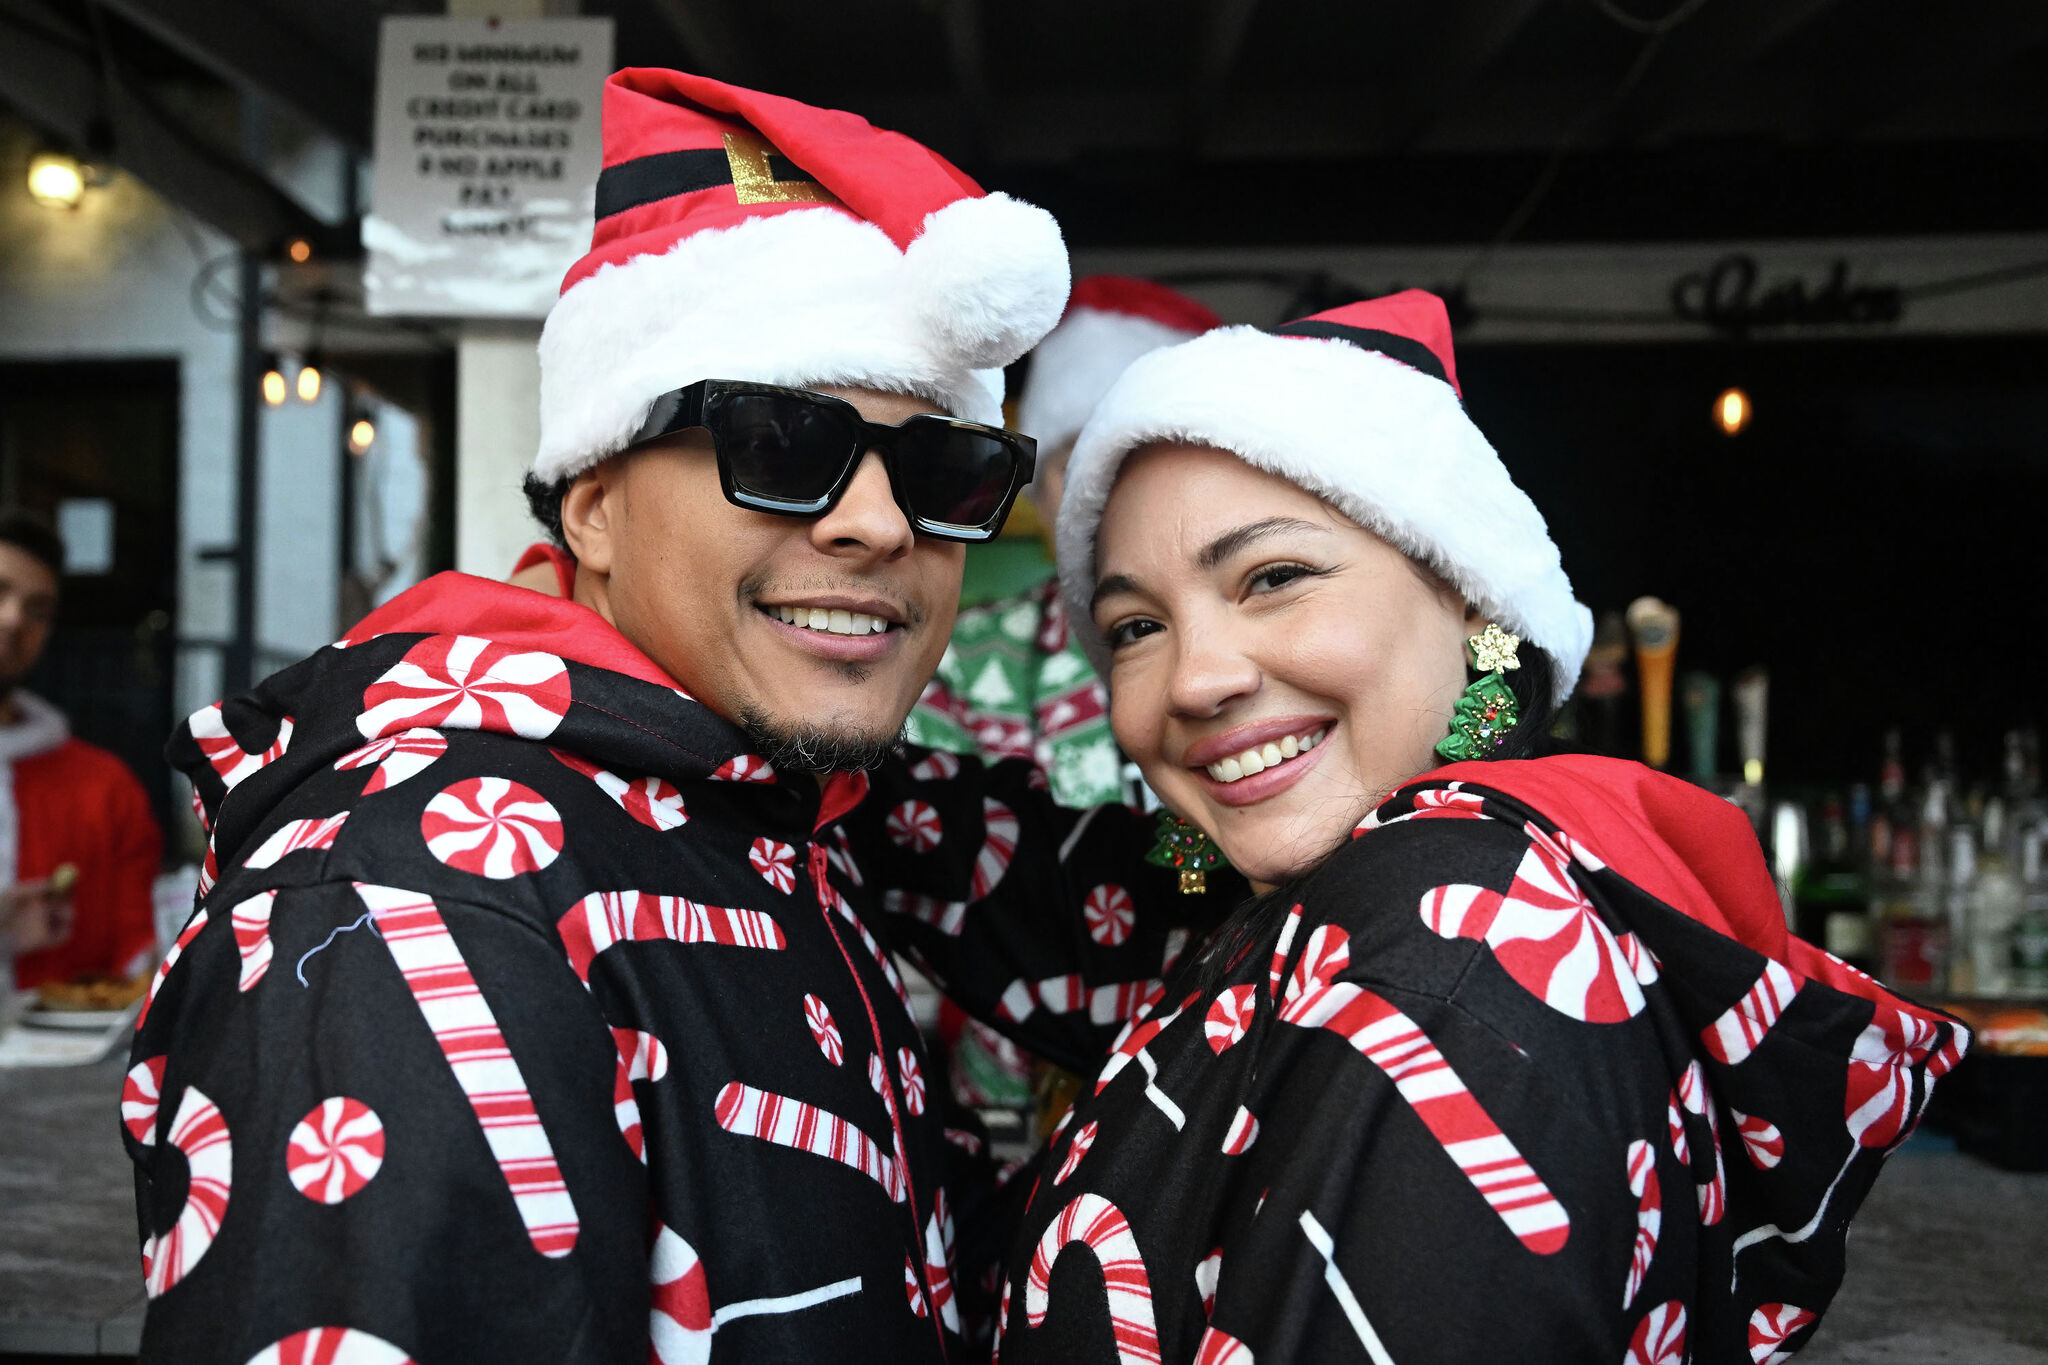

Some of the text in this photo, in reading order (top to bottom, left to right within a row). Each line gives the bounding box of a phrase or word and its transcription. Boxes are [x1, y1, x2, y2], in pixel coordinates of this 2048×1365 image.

[456, 44, 581, 65] MINIMUM
[449, 70, 538, 92] ON ALL
[406, 97, 580, 121] CREDIT CARD
[412, 126, 571, 151] PURCHASES
[485, 154, 563, 179] APPLE
[458, 183, 512, 204] PAY
